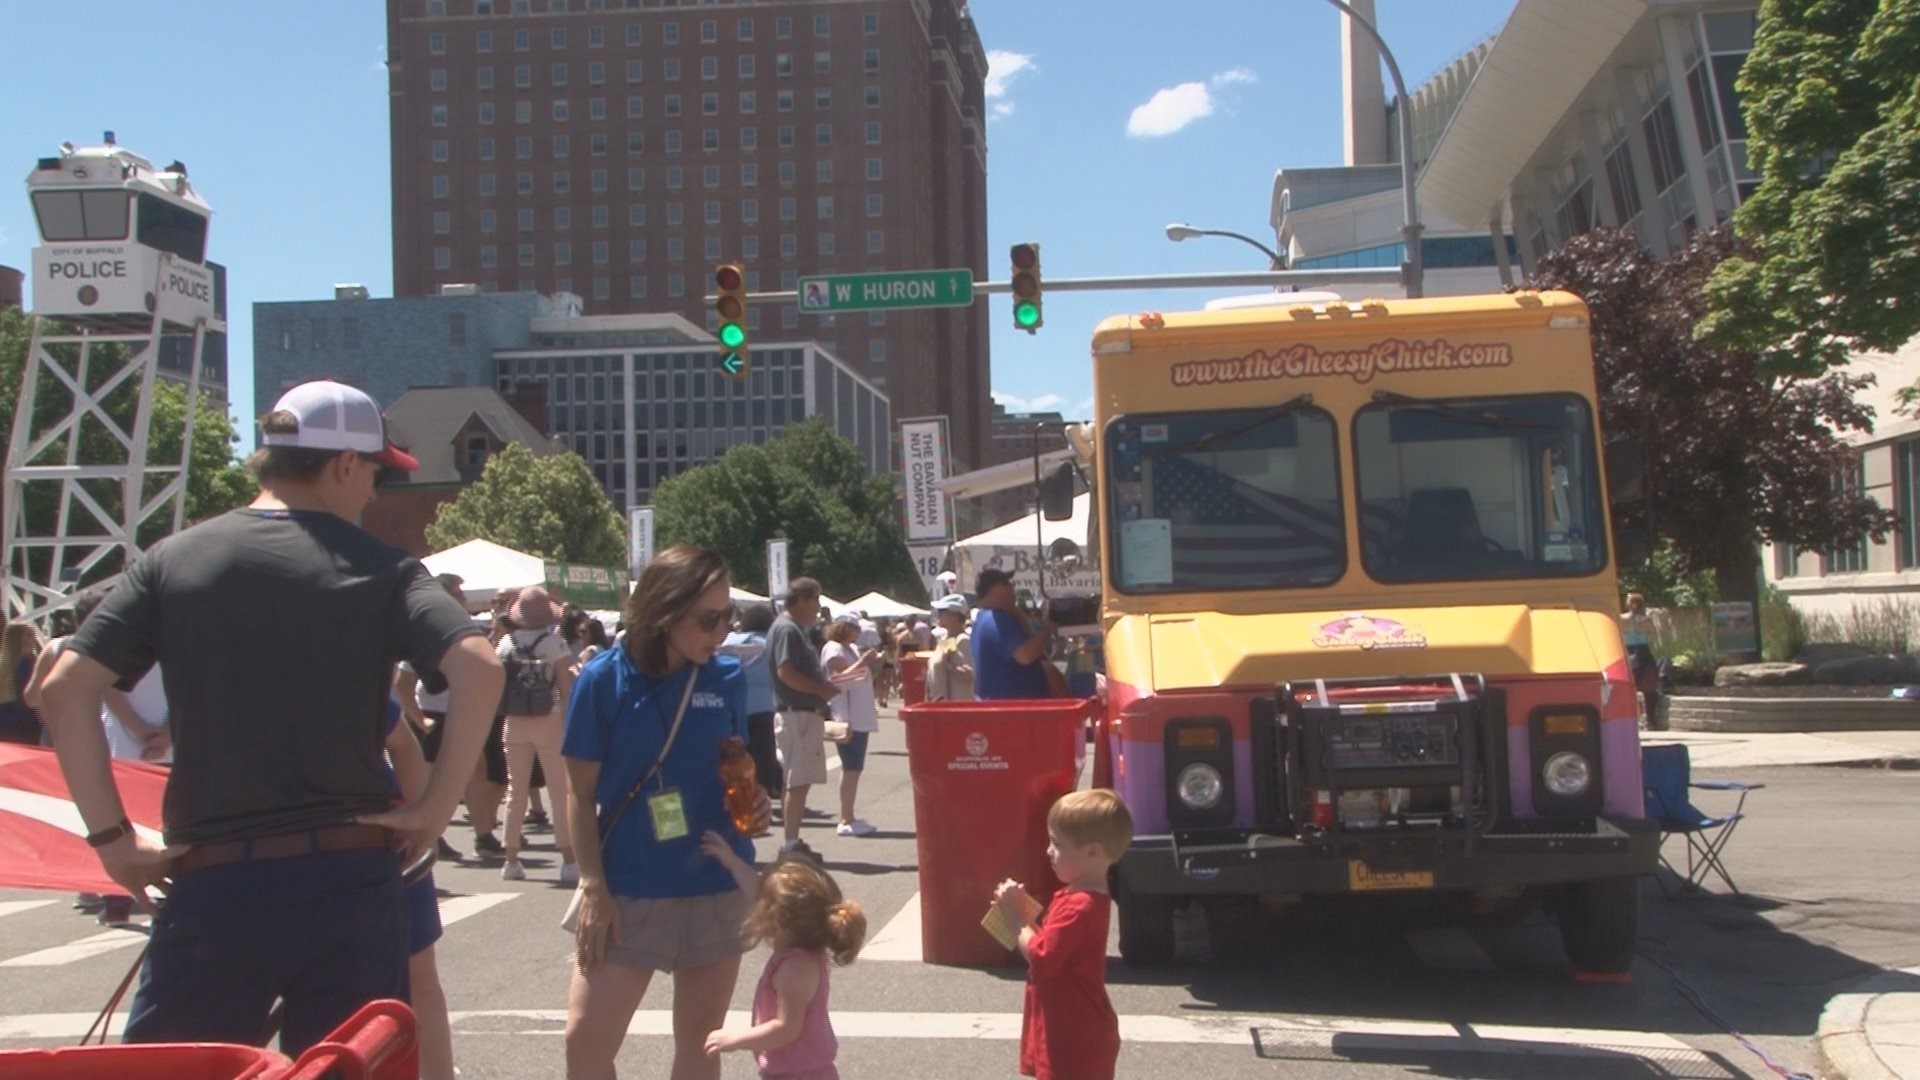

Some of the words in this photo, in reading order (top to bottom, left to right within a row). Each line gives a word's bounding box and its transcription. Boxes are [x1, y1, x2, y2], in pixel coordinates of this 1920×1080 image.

[49, 260, 127, 279] POLICE
[170, 273, 209, 303] POLICE
[835, 283, 851, 302] W
[863, 279, 936, 301] HURON
[1171, 338, 1513, 387] www.theCheesyChick.com
[910, 432, 922, 460] NUT
[922, 432, 934, 459] THE
[912, 461, 926, 527] COMPANY
[924, 461, 938, 526] BAVARIAN
[918, 556, 938, 576] 18
[692, 697, 724, 708] NEWS
